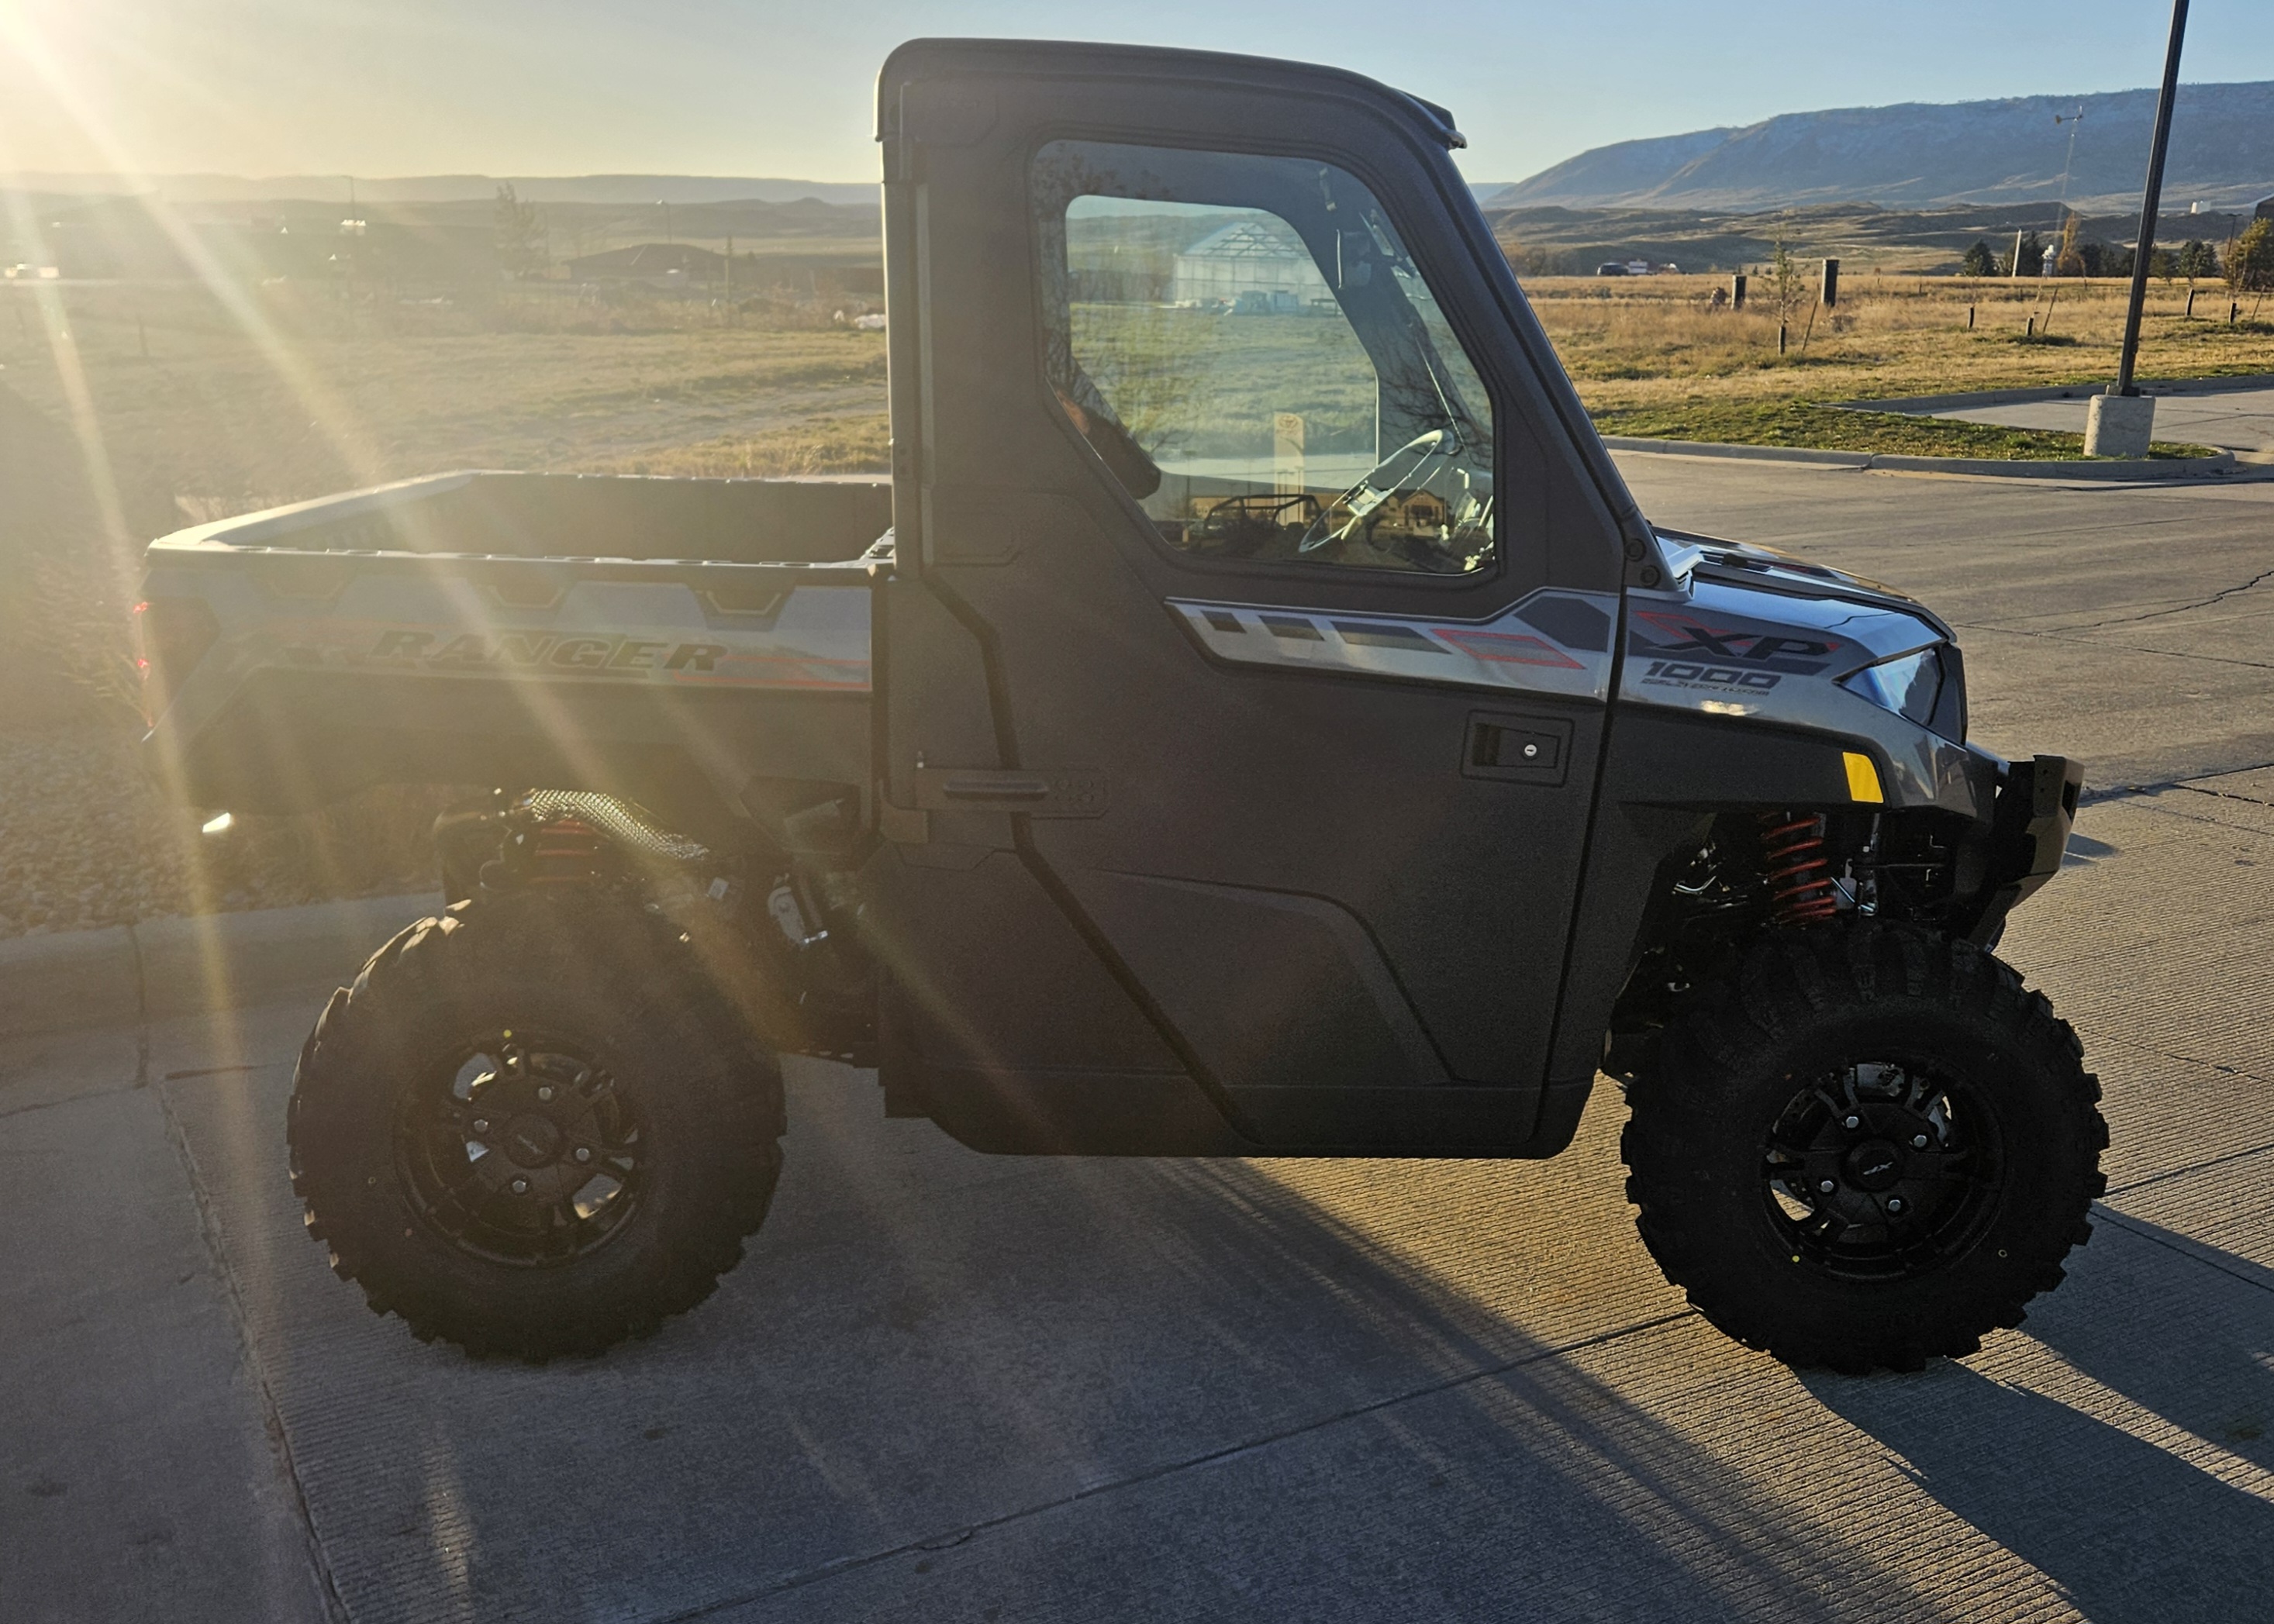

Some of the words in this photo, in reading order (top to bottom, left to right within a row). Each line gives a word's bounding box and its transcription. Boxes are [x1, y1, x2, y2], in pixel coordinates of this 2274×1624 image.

[367, 629, 730, 671] RANGER
[1648, 626, 1832, 660] XP
[1644, 661, 1782, 690] 1000
